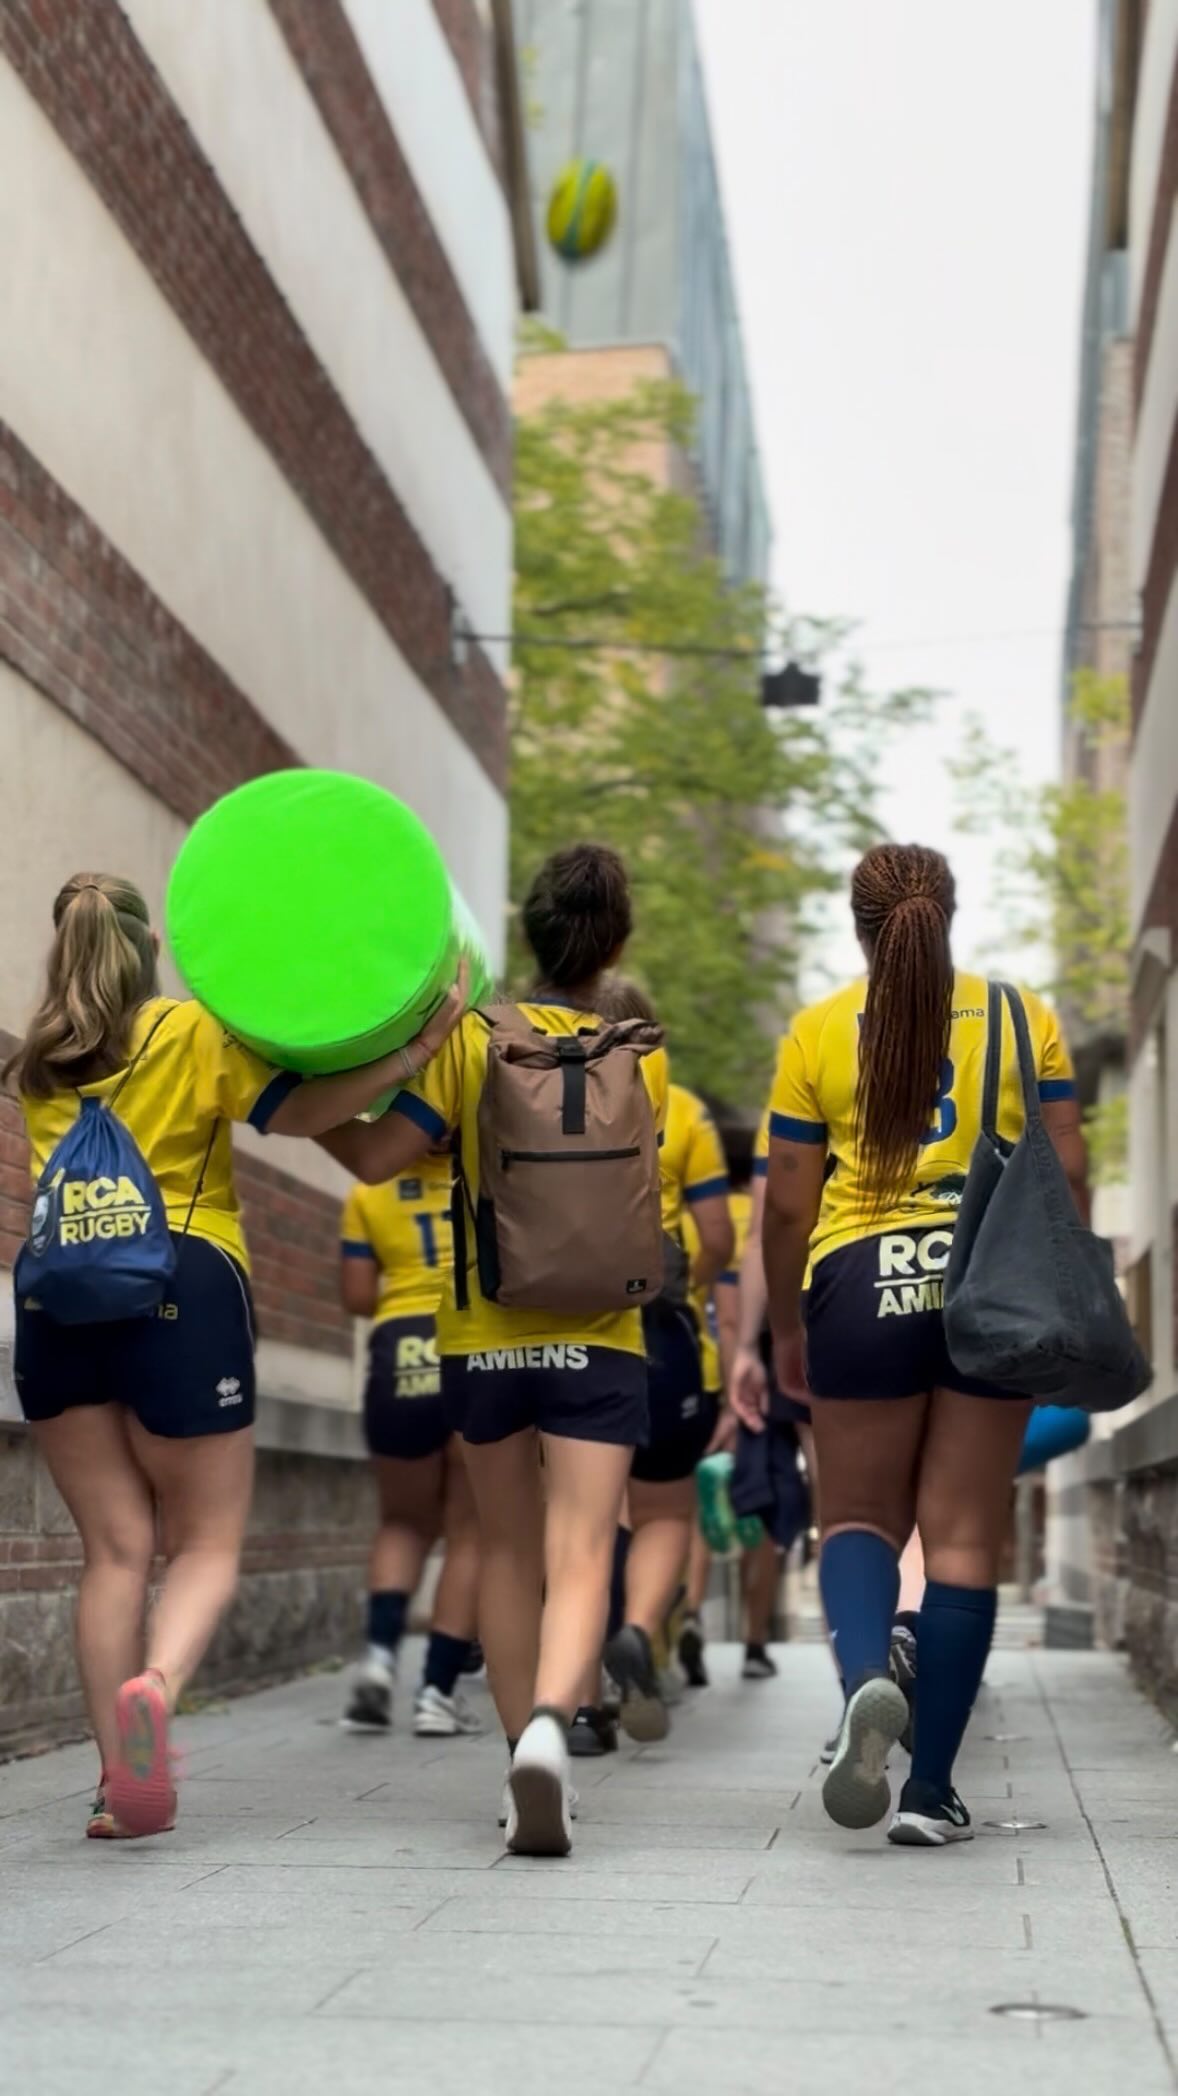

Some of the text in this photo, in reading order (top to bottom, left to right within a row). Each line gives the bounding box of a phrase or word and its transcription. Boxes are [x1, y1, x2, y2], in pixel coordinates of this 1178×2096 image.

[62, 1176, 145, 1214] RCA
[60, 1212, 151, 1246] RUGBY
[877, 1282, 944, 1318] AMI
[467, 1343, 589, 1372] AMIENS
